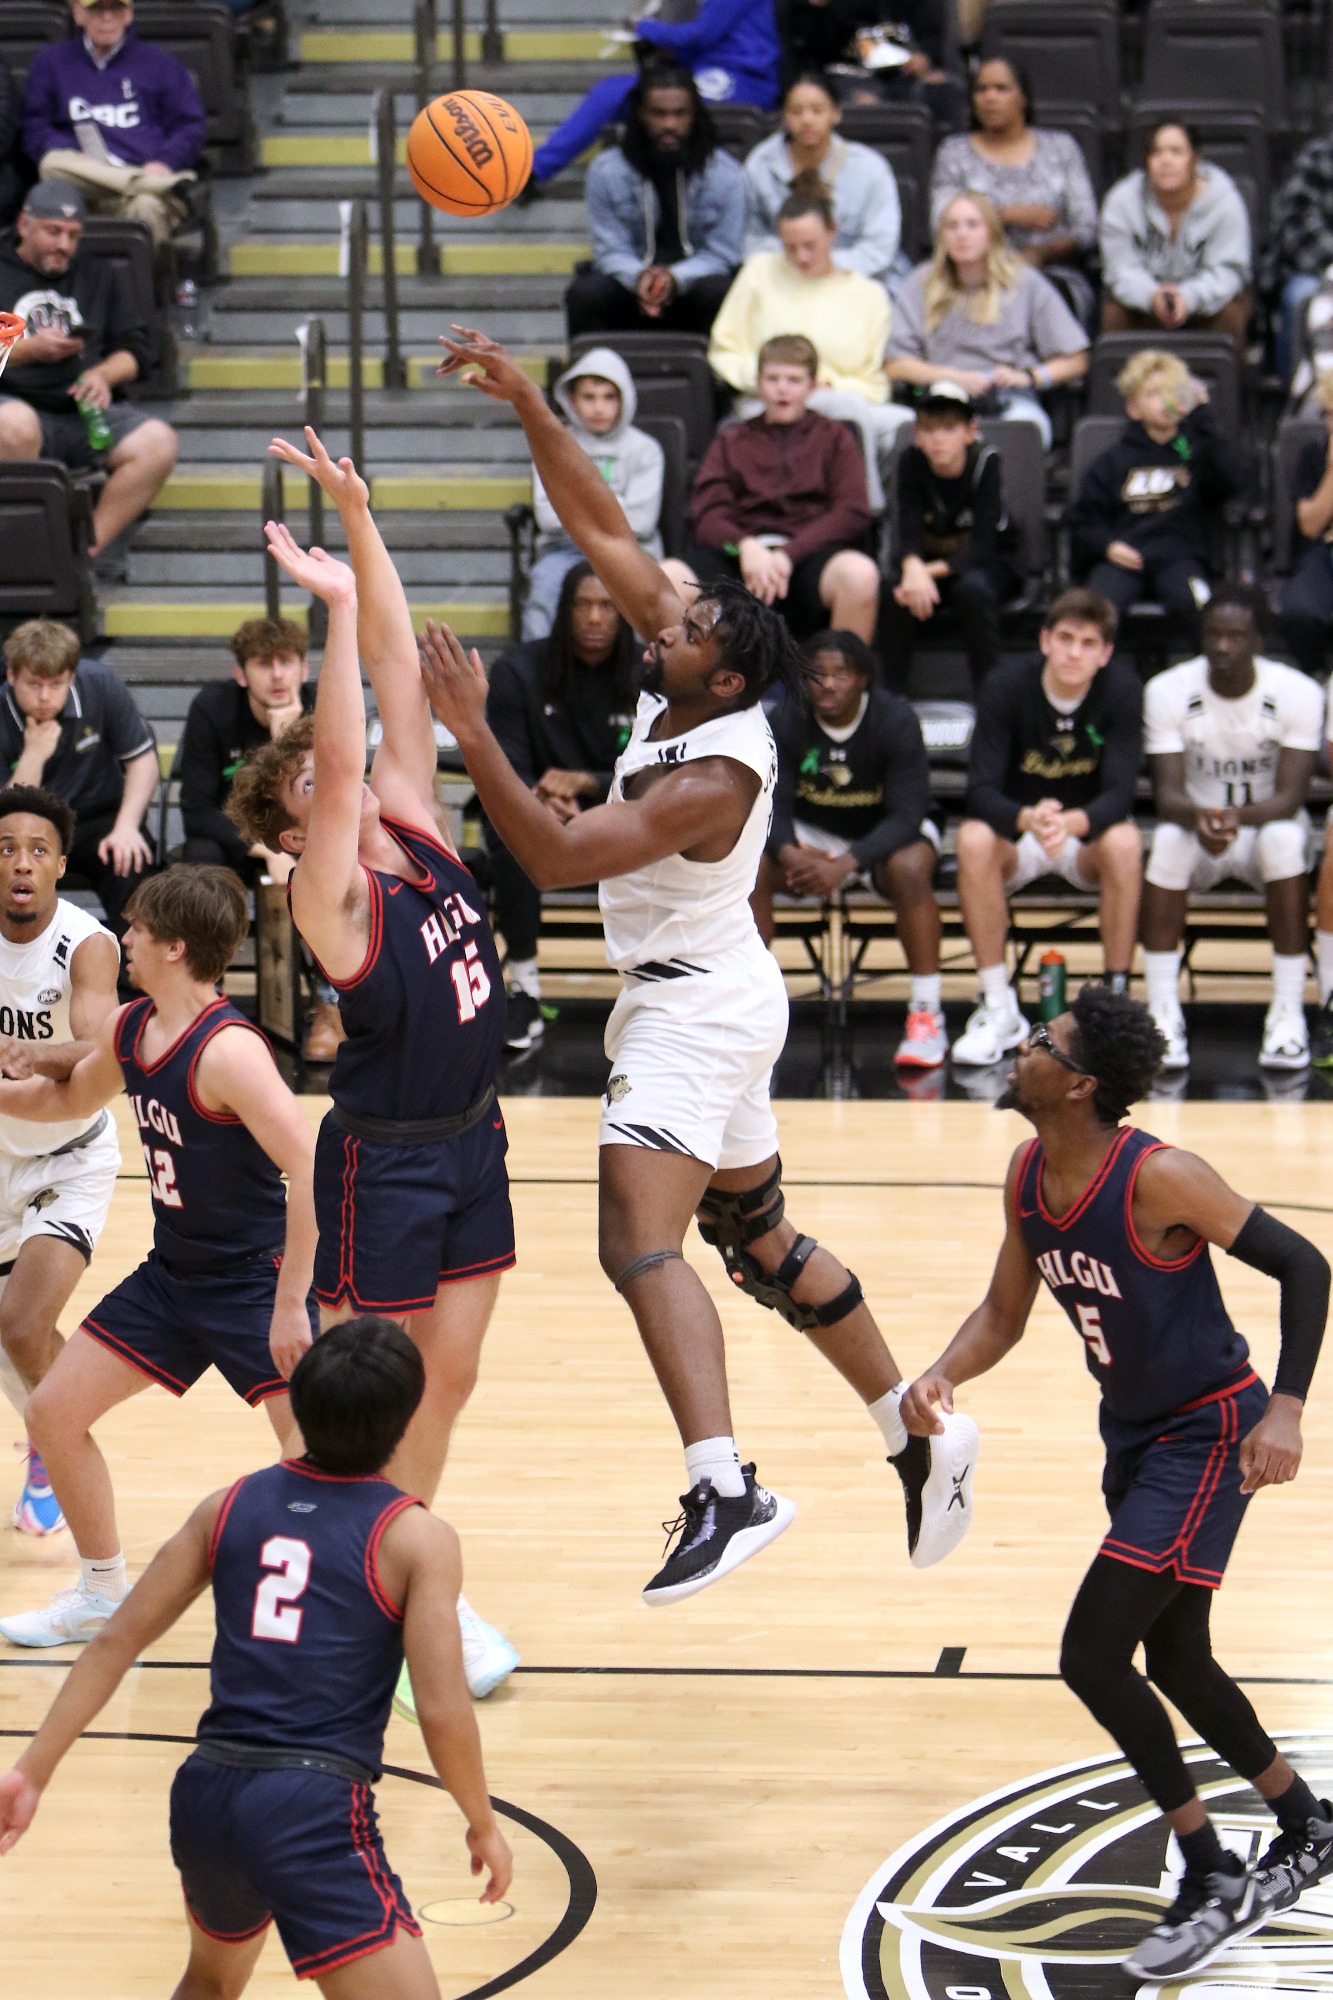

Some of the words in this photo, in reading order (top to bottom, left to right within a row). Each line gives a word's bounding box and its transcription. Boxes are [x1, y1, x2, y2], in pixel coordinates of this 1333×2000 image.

[442, 97, 493, 169] Wilson
[1221, 781, 1254, 806] 11
[450, 938, 491, 1025] 15
[1036, 1249, 1123, 1300] HLGU
[1075, 1302, 1113, 1367] 5
[251, 1534, 314, 1645] 2
[963, 1798, 1119, 1888] VALL
